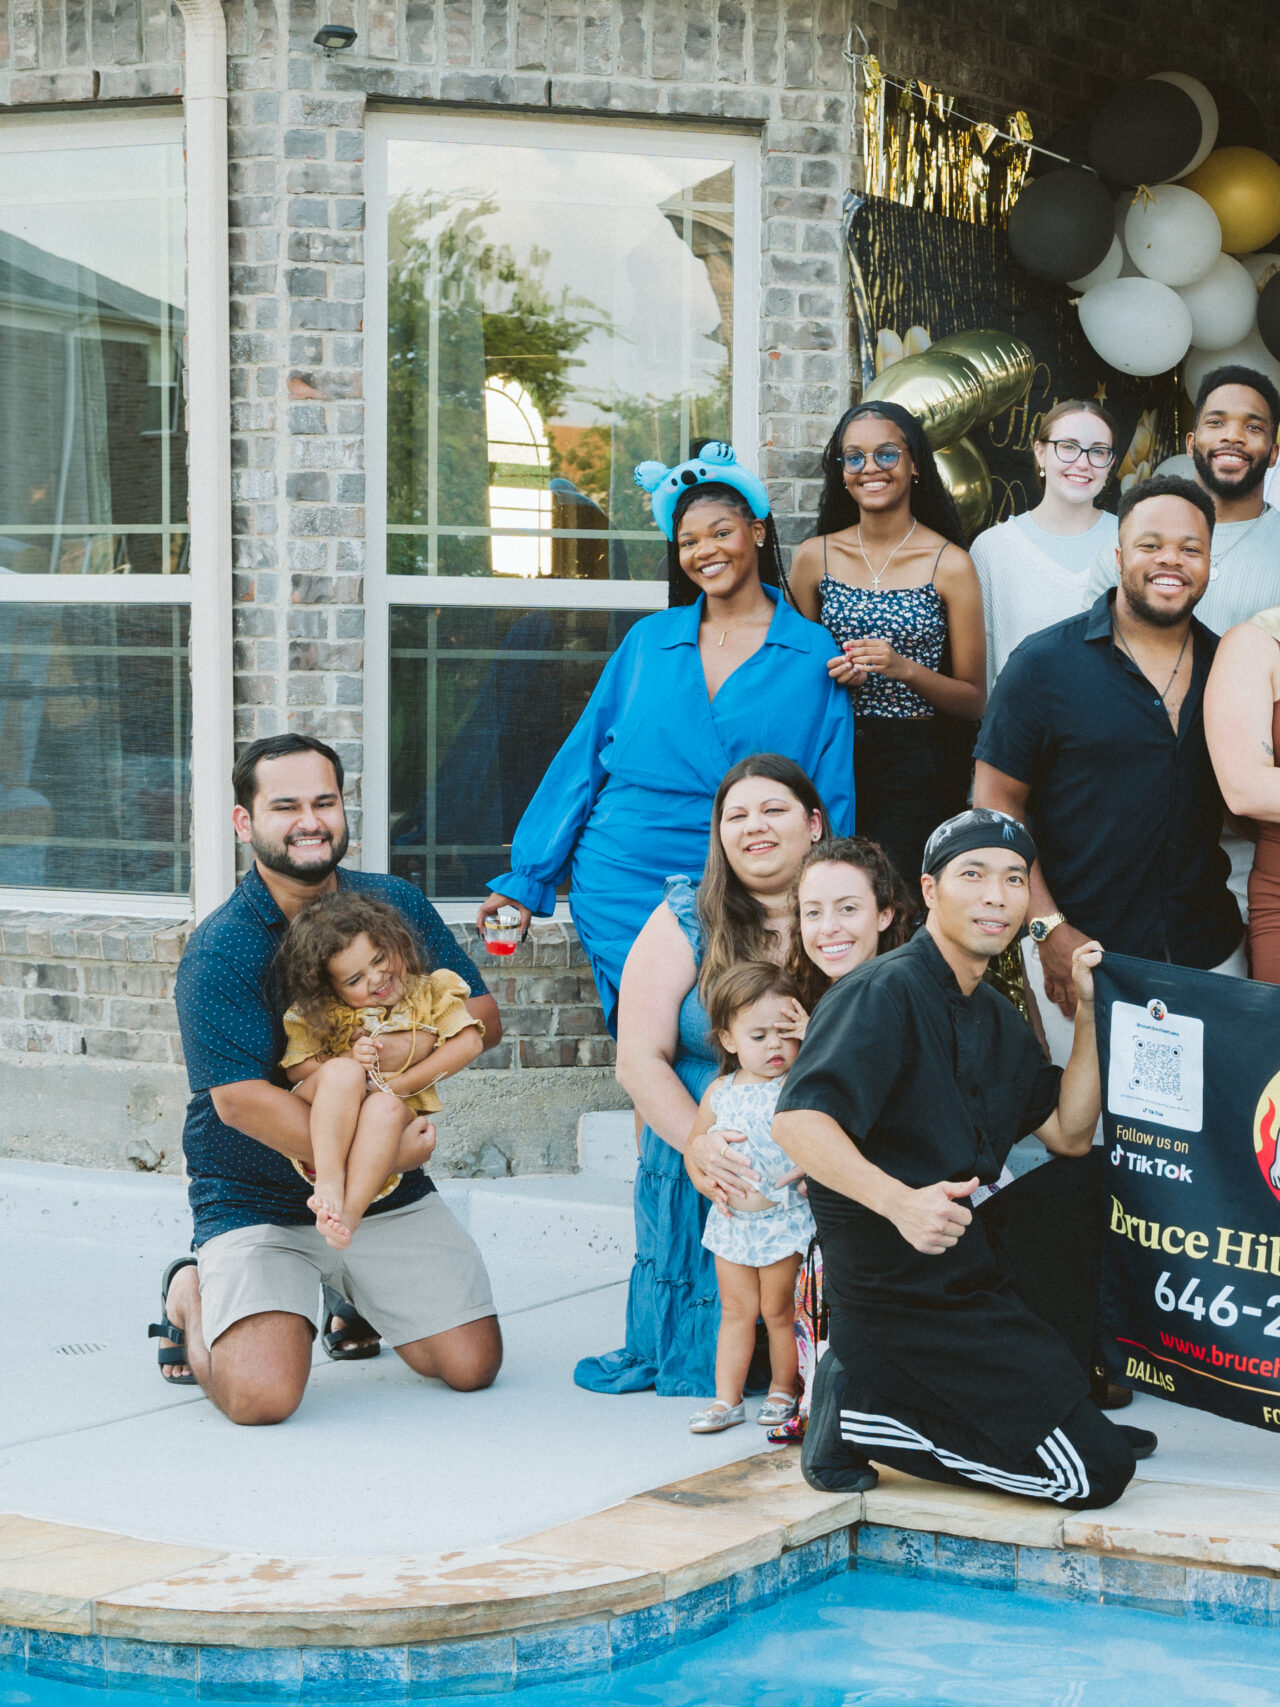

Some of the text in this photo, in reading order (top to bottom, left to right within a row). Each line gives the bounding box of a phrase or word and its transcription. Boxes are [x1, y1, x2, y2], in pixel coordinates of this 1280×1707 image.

[1116, 1124, 1189, 1155] Follow us on
[1126, 1151, 1193, 1184] TikTok
[1110, 1194, 1210, 1260] Bruce
[1126, 1357, 1175, 1392] DALLAS
